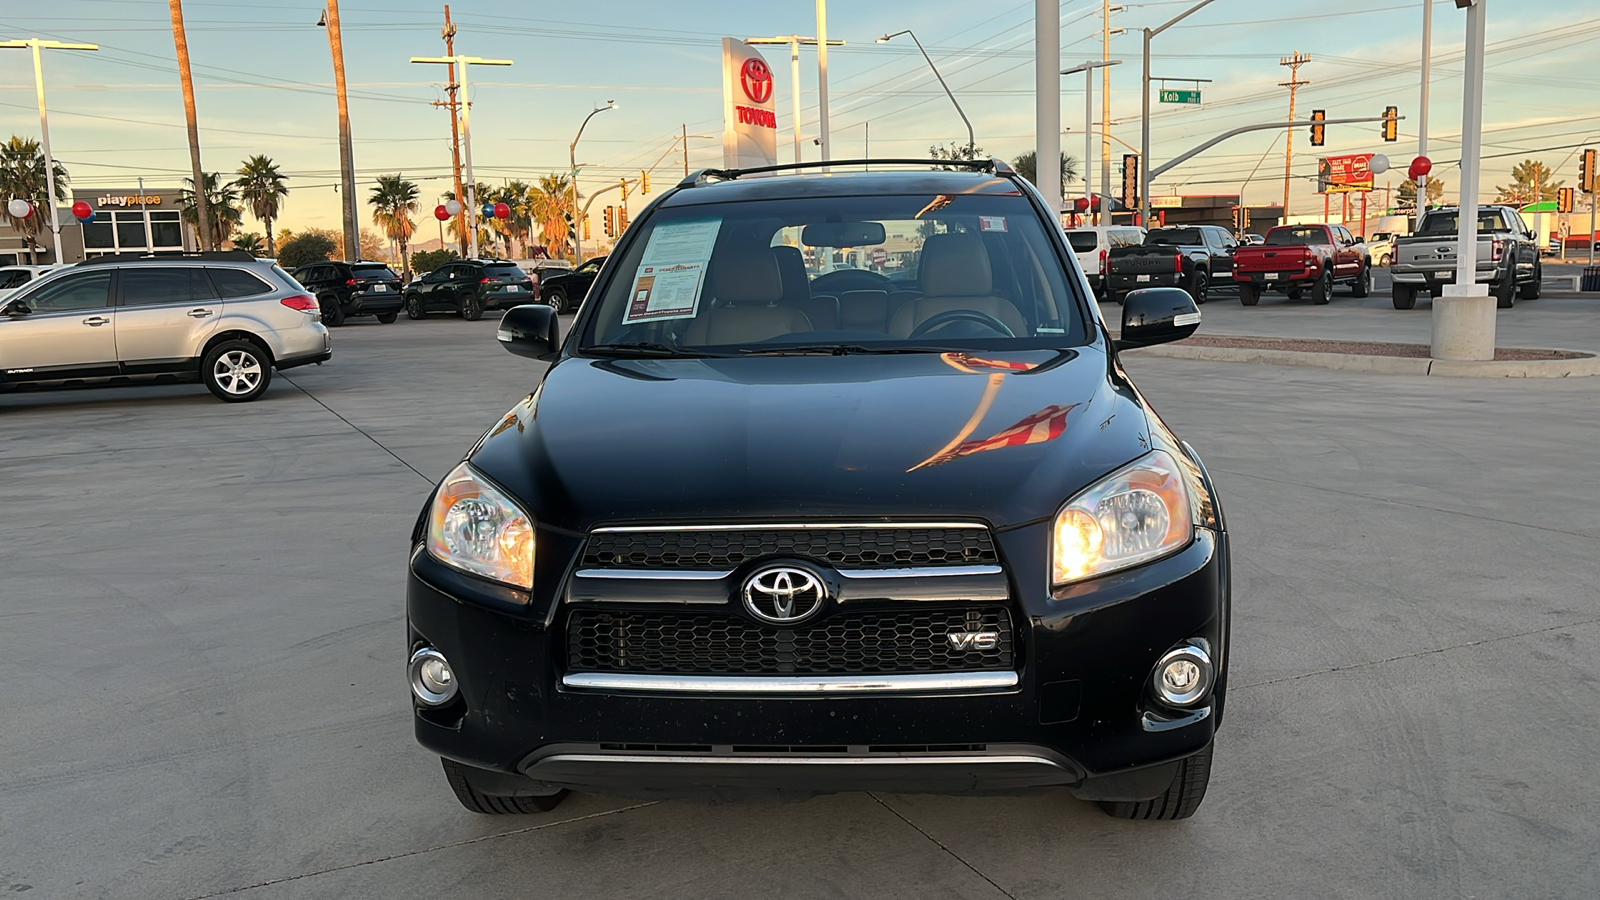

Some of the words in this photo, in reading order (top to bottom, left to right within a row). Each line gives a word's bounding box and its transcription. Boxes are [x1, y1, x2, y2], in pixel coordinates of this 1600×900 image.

[1164, 91, 1179, 102] Kolb
[736, 105, 776, 129] TOYOTA
[97, 194, 161, 207] playplace
[1389, 207, 1417, 216] enterpri
[947, 631, 998, 651] V6
